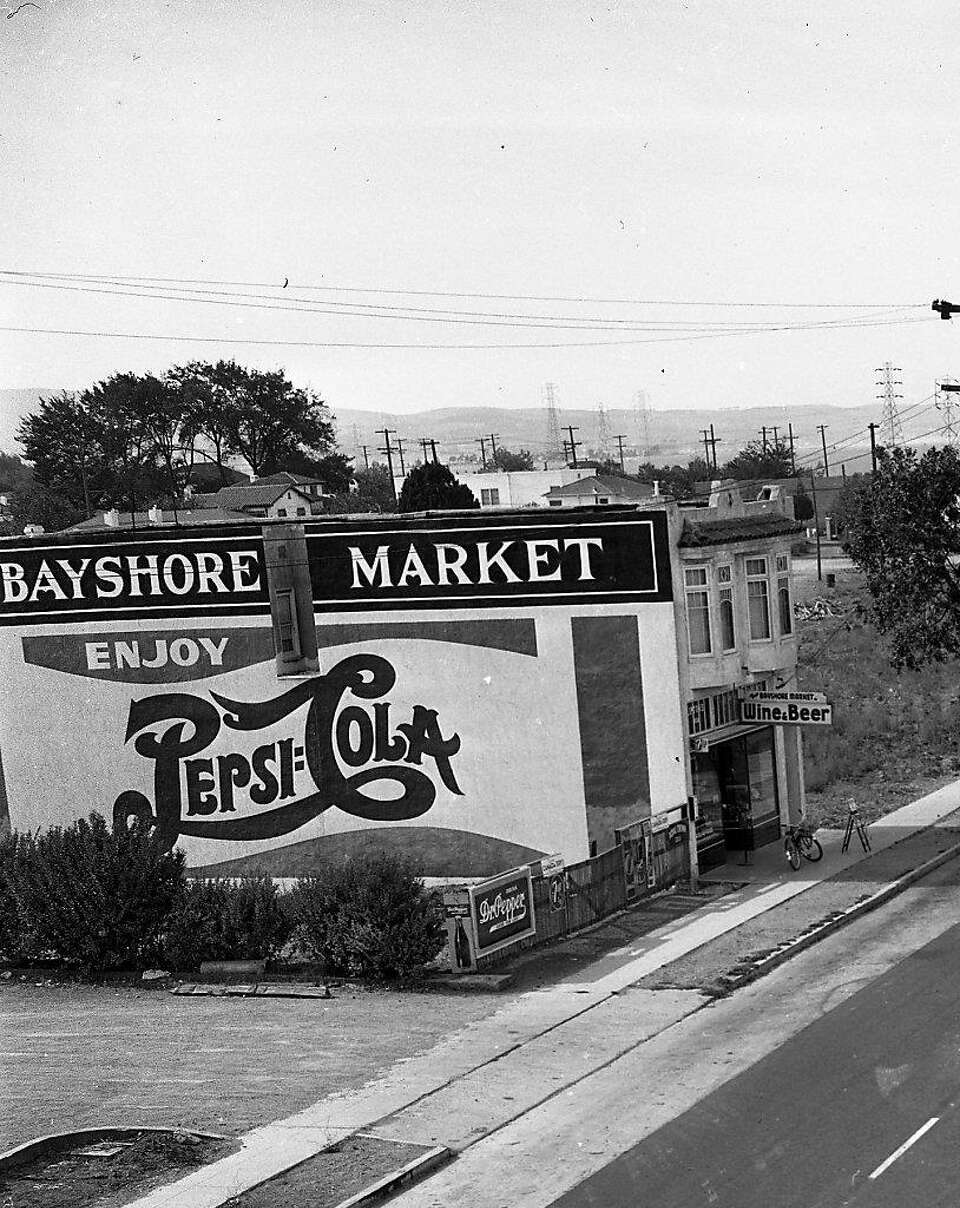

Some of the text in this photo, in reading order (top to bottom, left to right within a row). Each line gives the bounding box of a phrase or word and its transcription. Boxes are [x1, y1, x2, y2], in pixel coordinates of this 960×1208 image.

[1, 537, 604, 603] BAYSHORE MARKET
[86, 636, 231, 671] ENJOY
